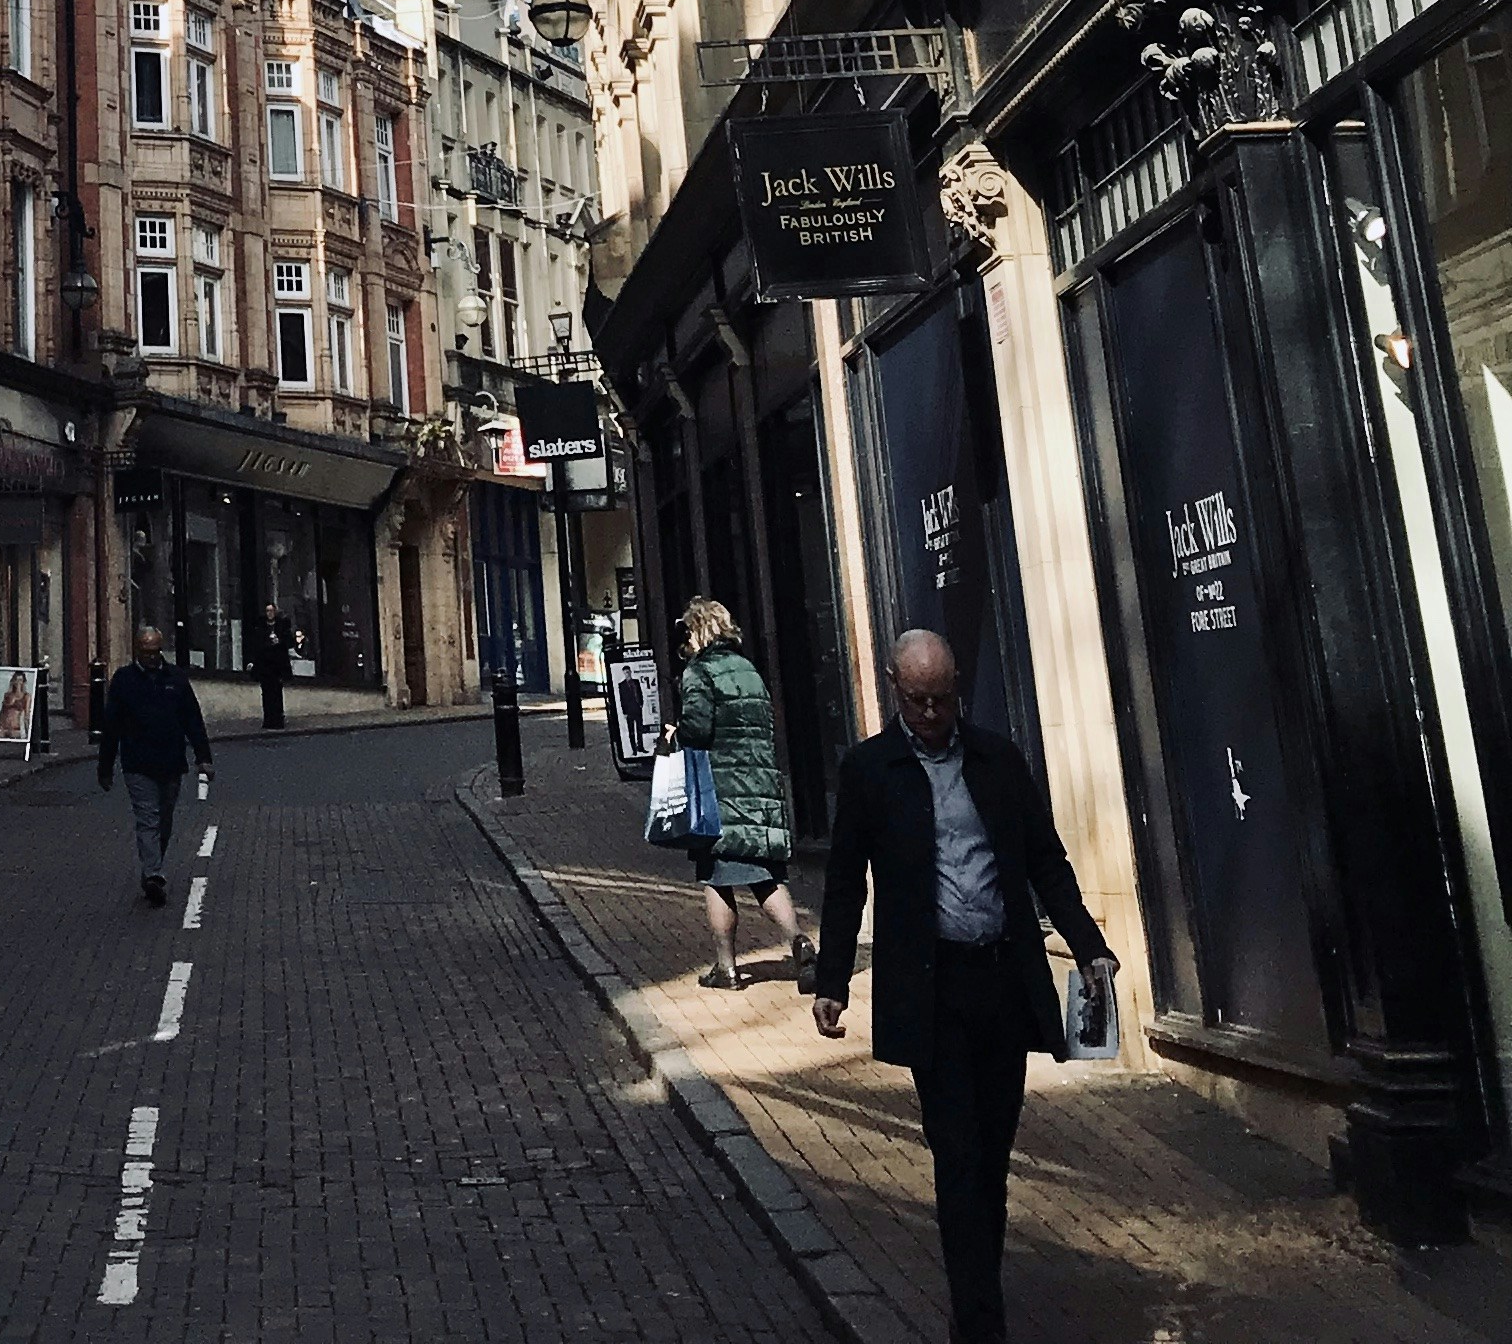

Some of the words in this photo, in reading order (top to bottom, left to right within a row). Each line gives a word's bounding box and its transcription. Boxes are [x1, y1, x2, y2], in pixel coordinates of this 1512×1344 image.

[760, 168, 820, 207] Jack
[823, 163, 896, 193] Wills
[779, 208, 885, 230] FABULOUSLY
[799, 226, 873, 246] BRITISH
[528, 437, 597, 459] slaters
[1165, 502, 1200, 579] Jack
[1194, 490, 1238, 552] Wills
[1190, 610, 1211, 633] FORE
[1209, 605, 1237, 630] STREET
